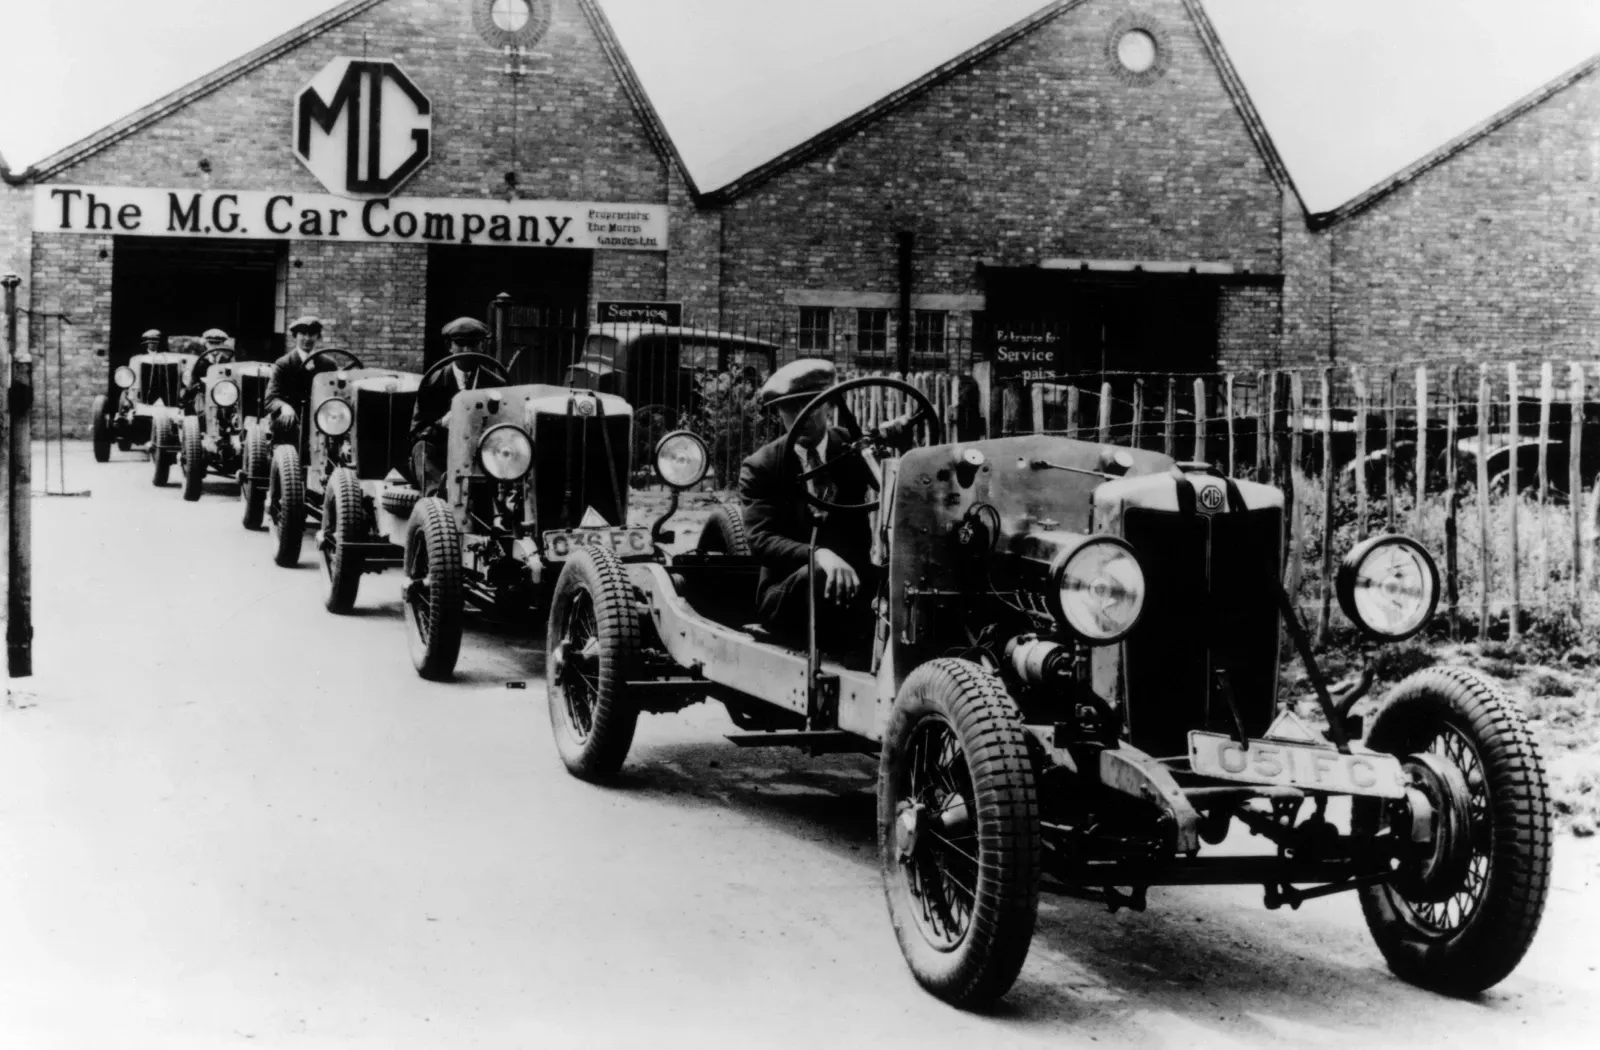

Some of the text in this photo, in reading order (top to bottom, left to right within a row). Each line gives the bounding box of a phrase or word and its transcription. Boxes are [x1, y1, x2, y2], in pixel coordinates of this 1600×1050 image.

[298, 60, 430, 194] MG
[51, 188, 574, 247] The M.G. Car Company.
[608, 223, 642, 233] Morris
[608, 304, 668, 319] Service
[997, 346, 1054, 362] Service
[1203, 489, 1221, 506] MG
